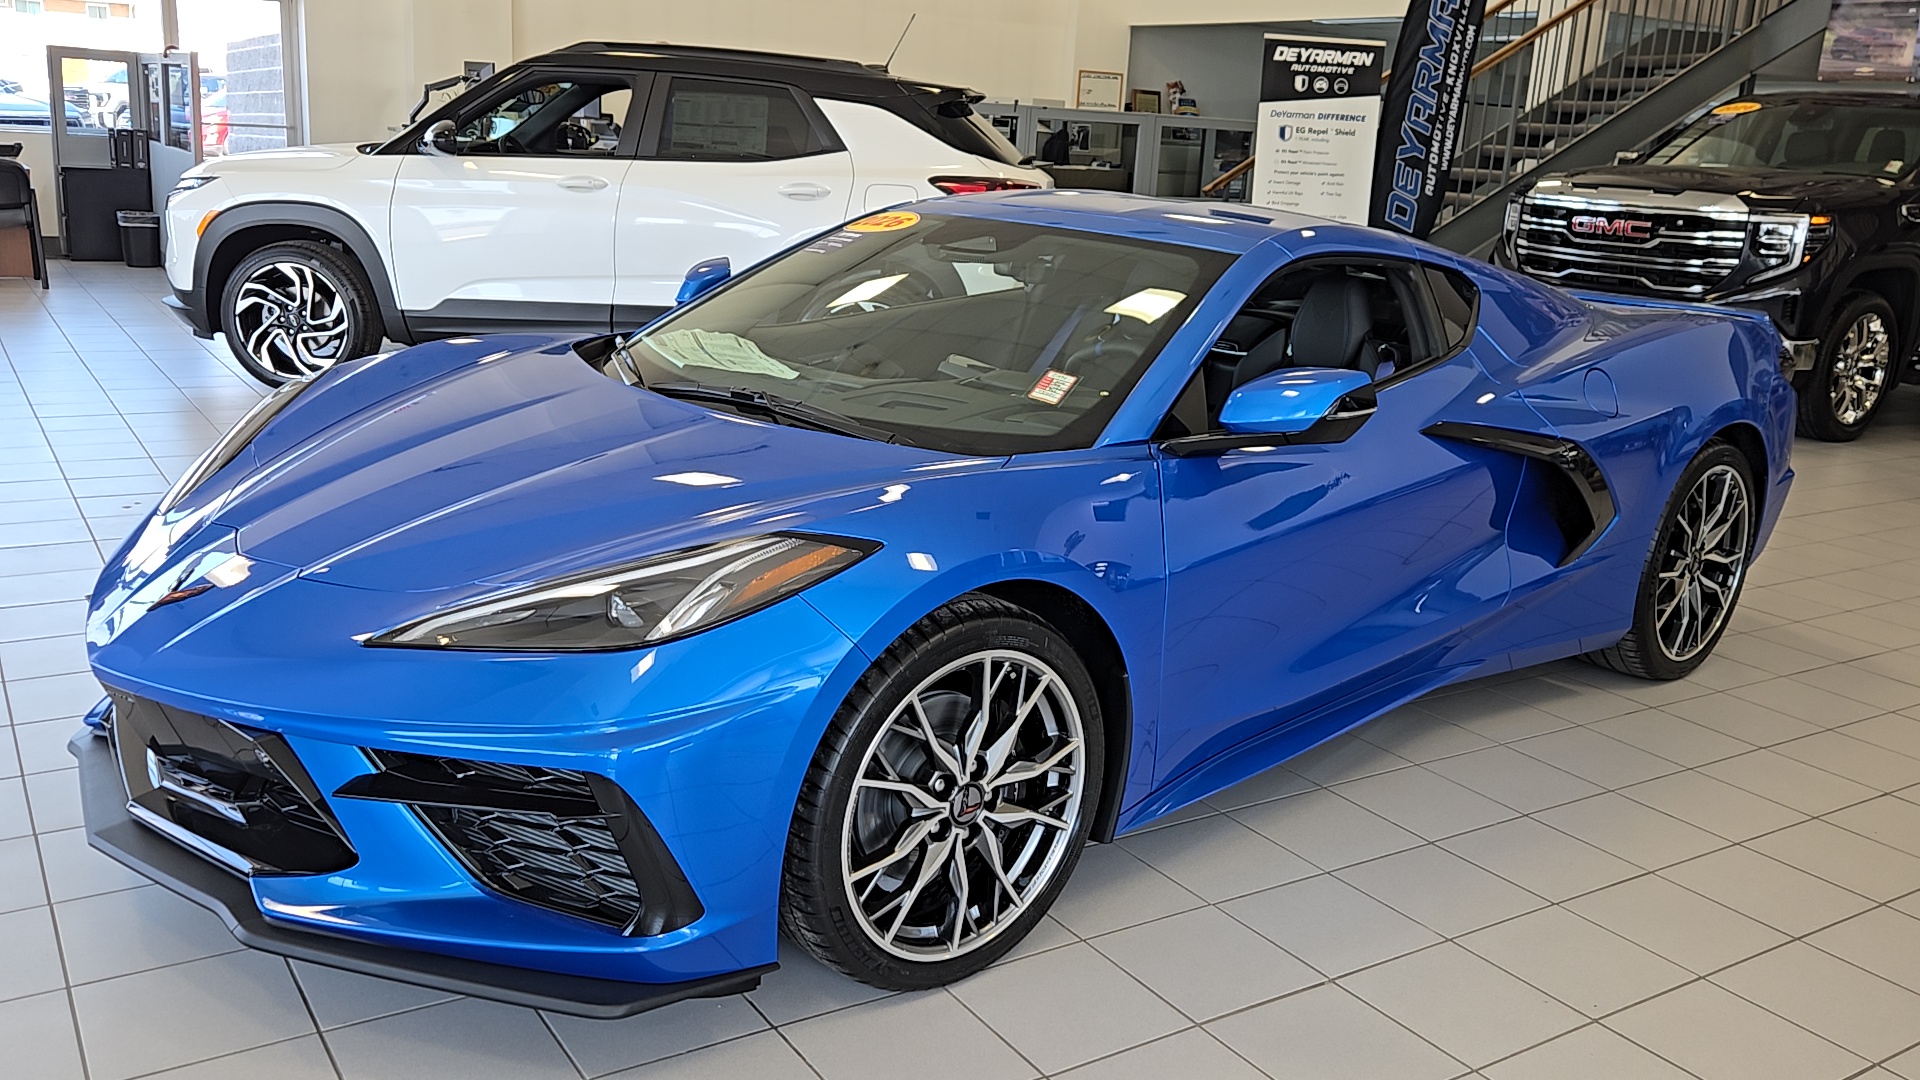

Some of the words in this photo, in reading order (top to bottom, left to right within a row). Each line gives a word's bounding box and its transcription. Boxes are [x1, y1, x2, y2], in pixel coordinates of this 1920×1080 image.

[1273, 46, 1374, 66] DEYARMAN
[1290, 63, 1355, 75] AUTOMOTIVE
[1270, 109, 1316, 120] DeYarman
[1317, 112, 1367, 123] DIFFERENCE
[1295, 126, 1306, 134] EG
[1334, 128, 1356, 137] Shield
[1425, 91, 1450, 196] AUTOMOTIVE
[1571, 215, 1653, 239] GMC
